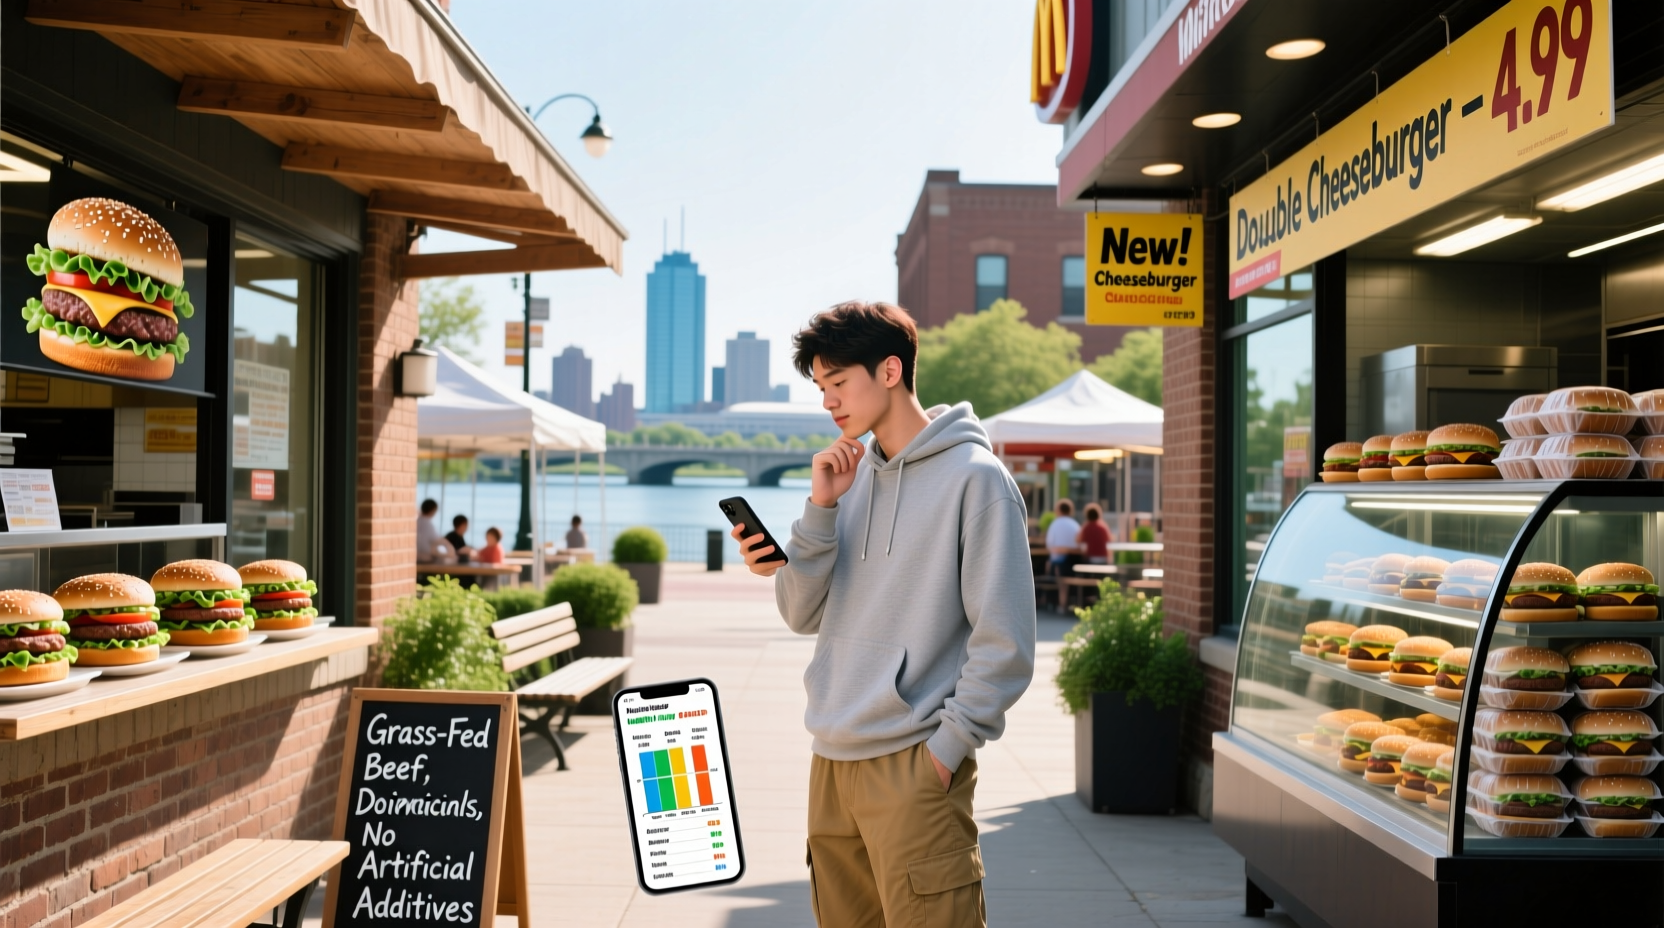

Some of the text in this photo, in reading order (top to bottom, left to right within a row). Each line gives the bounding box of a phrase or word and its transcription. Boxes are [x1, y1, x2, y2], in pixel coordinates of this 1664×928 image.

[1306, 98, 1452, 190] Cheeseburger
[1491, 0, 1593, 133] 4.99
[1100, 227, 1192, 266] New!
[1094, 270, 1197, 292] Cheeseburger
[366, 713, 492, 748] Grass-Fed
[363, 752, 430, 786] Beef,
[362, 821, 396, 847] No
[357, 850, 474, 881] Artificial
[352, 886, 474, 923] Additives
